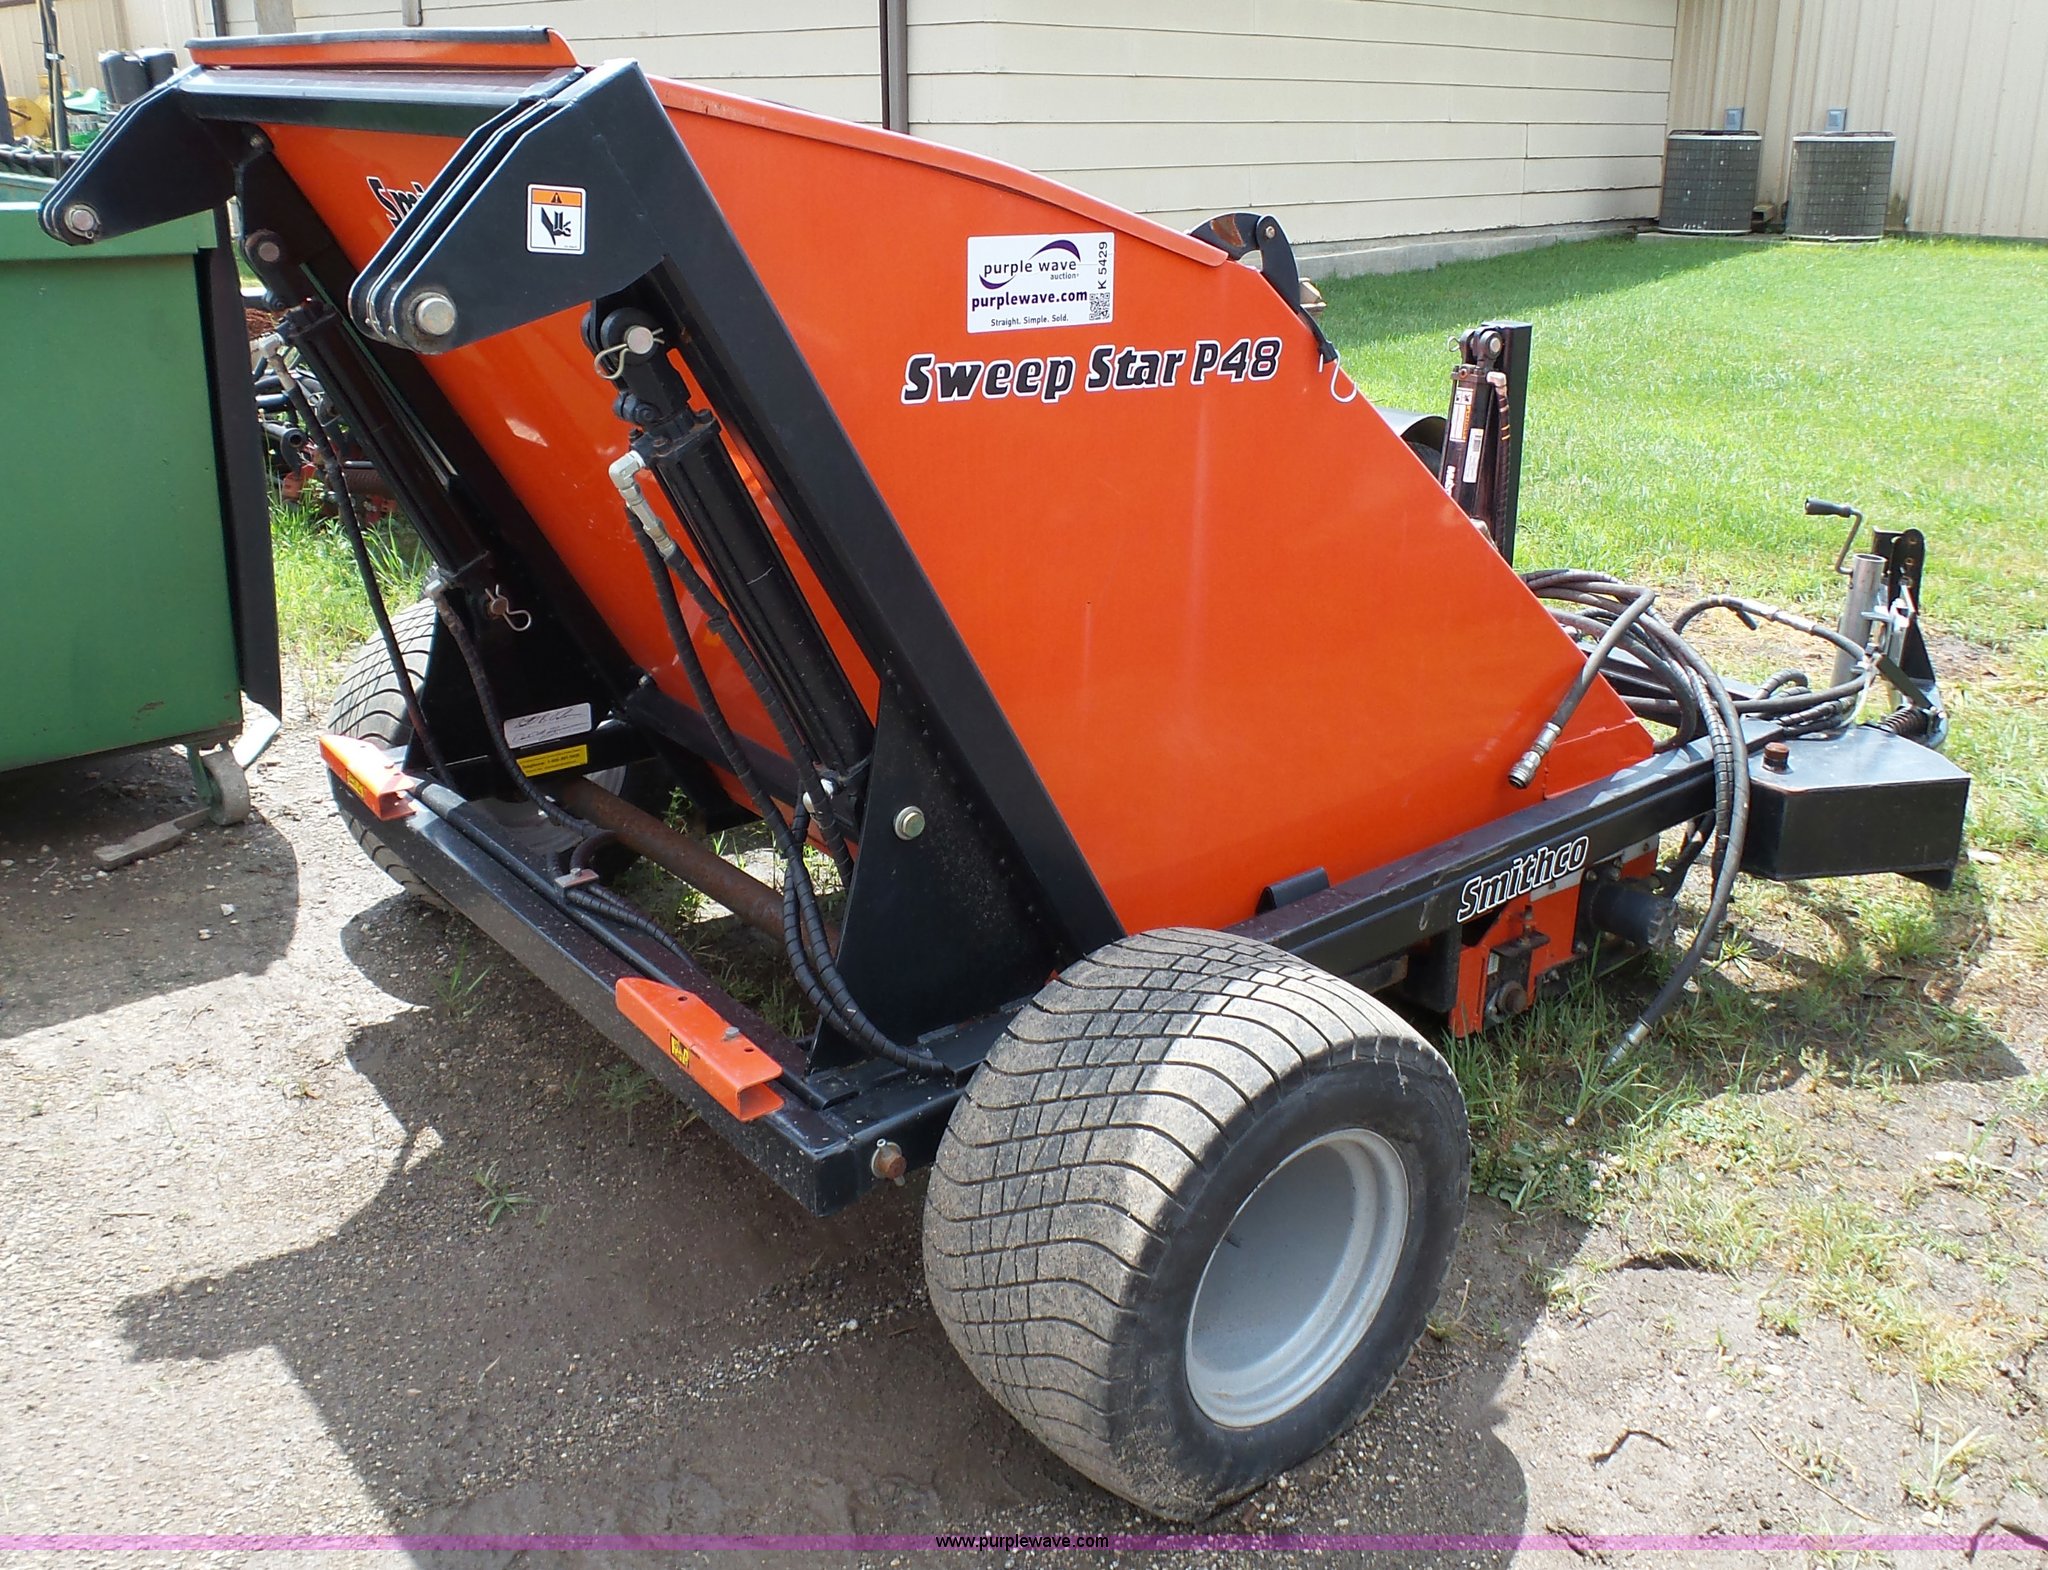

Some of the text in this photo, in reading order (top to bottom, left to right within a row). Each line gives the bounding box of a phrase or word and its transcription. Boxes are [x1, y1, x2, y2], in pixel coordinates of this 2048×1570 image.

[984, 260, 1077, 278] purple wave
[1098, 241, 1108, 290] K 5429
[971, 291, 1088, 311] purplewave.com
[991, 314, 1069, 328] Straight. Simple. Sold.
[901, 336, 1283, 404] Sweep Star P48
[1456, 836, 1589, 923] Smithco
